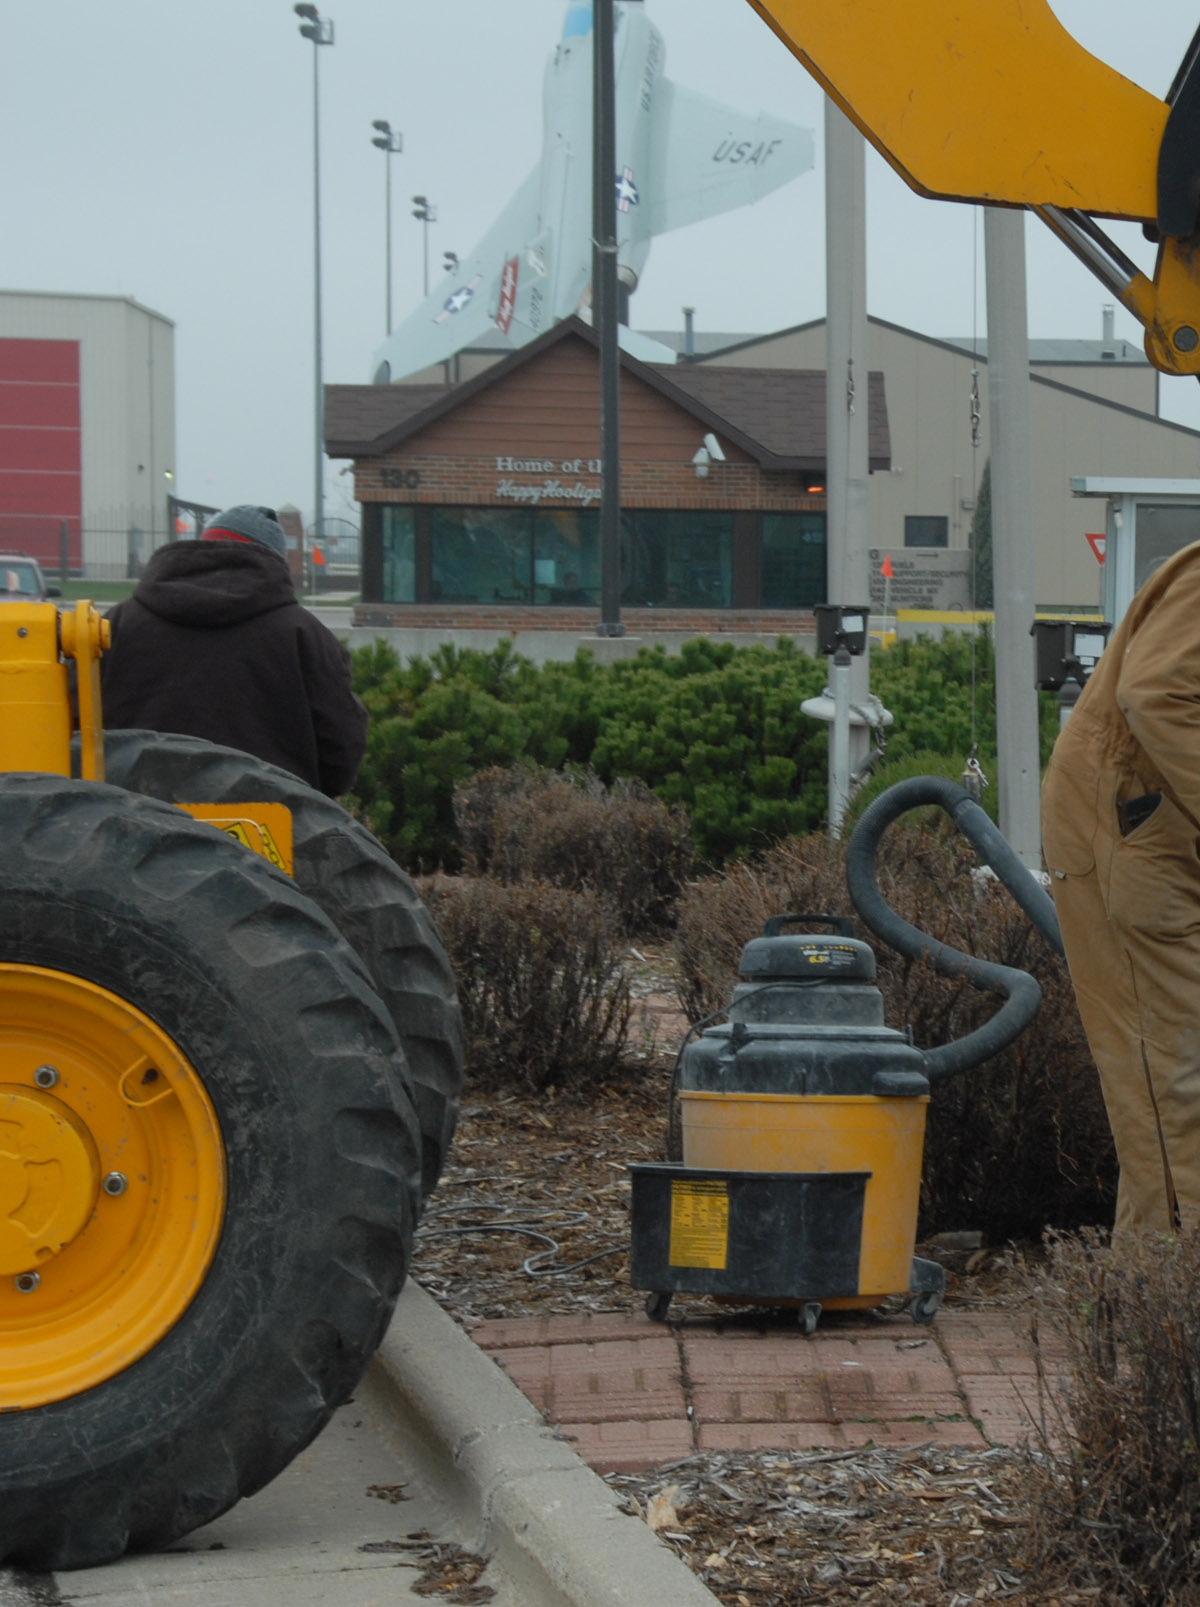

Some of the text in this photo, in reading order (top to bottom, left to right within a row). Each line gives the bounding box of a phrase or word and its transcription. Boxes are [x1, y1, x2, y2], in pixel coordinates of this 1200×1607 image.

[712, 139, 783, 166] USAF
[496, 456, 554, 474] Home
[561, 458, 582, 474] of
[496, 479, 604, 507] Happy Hooliga
